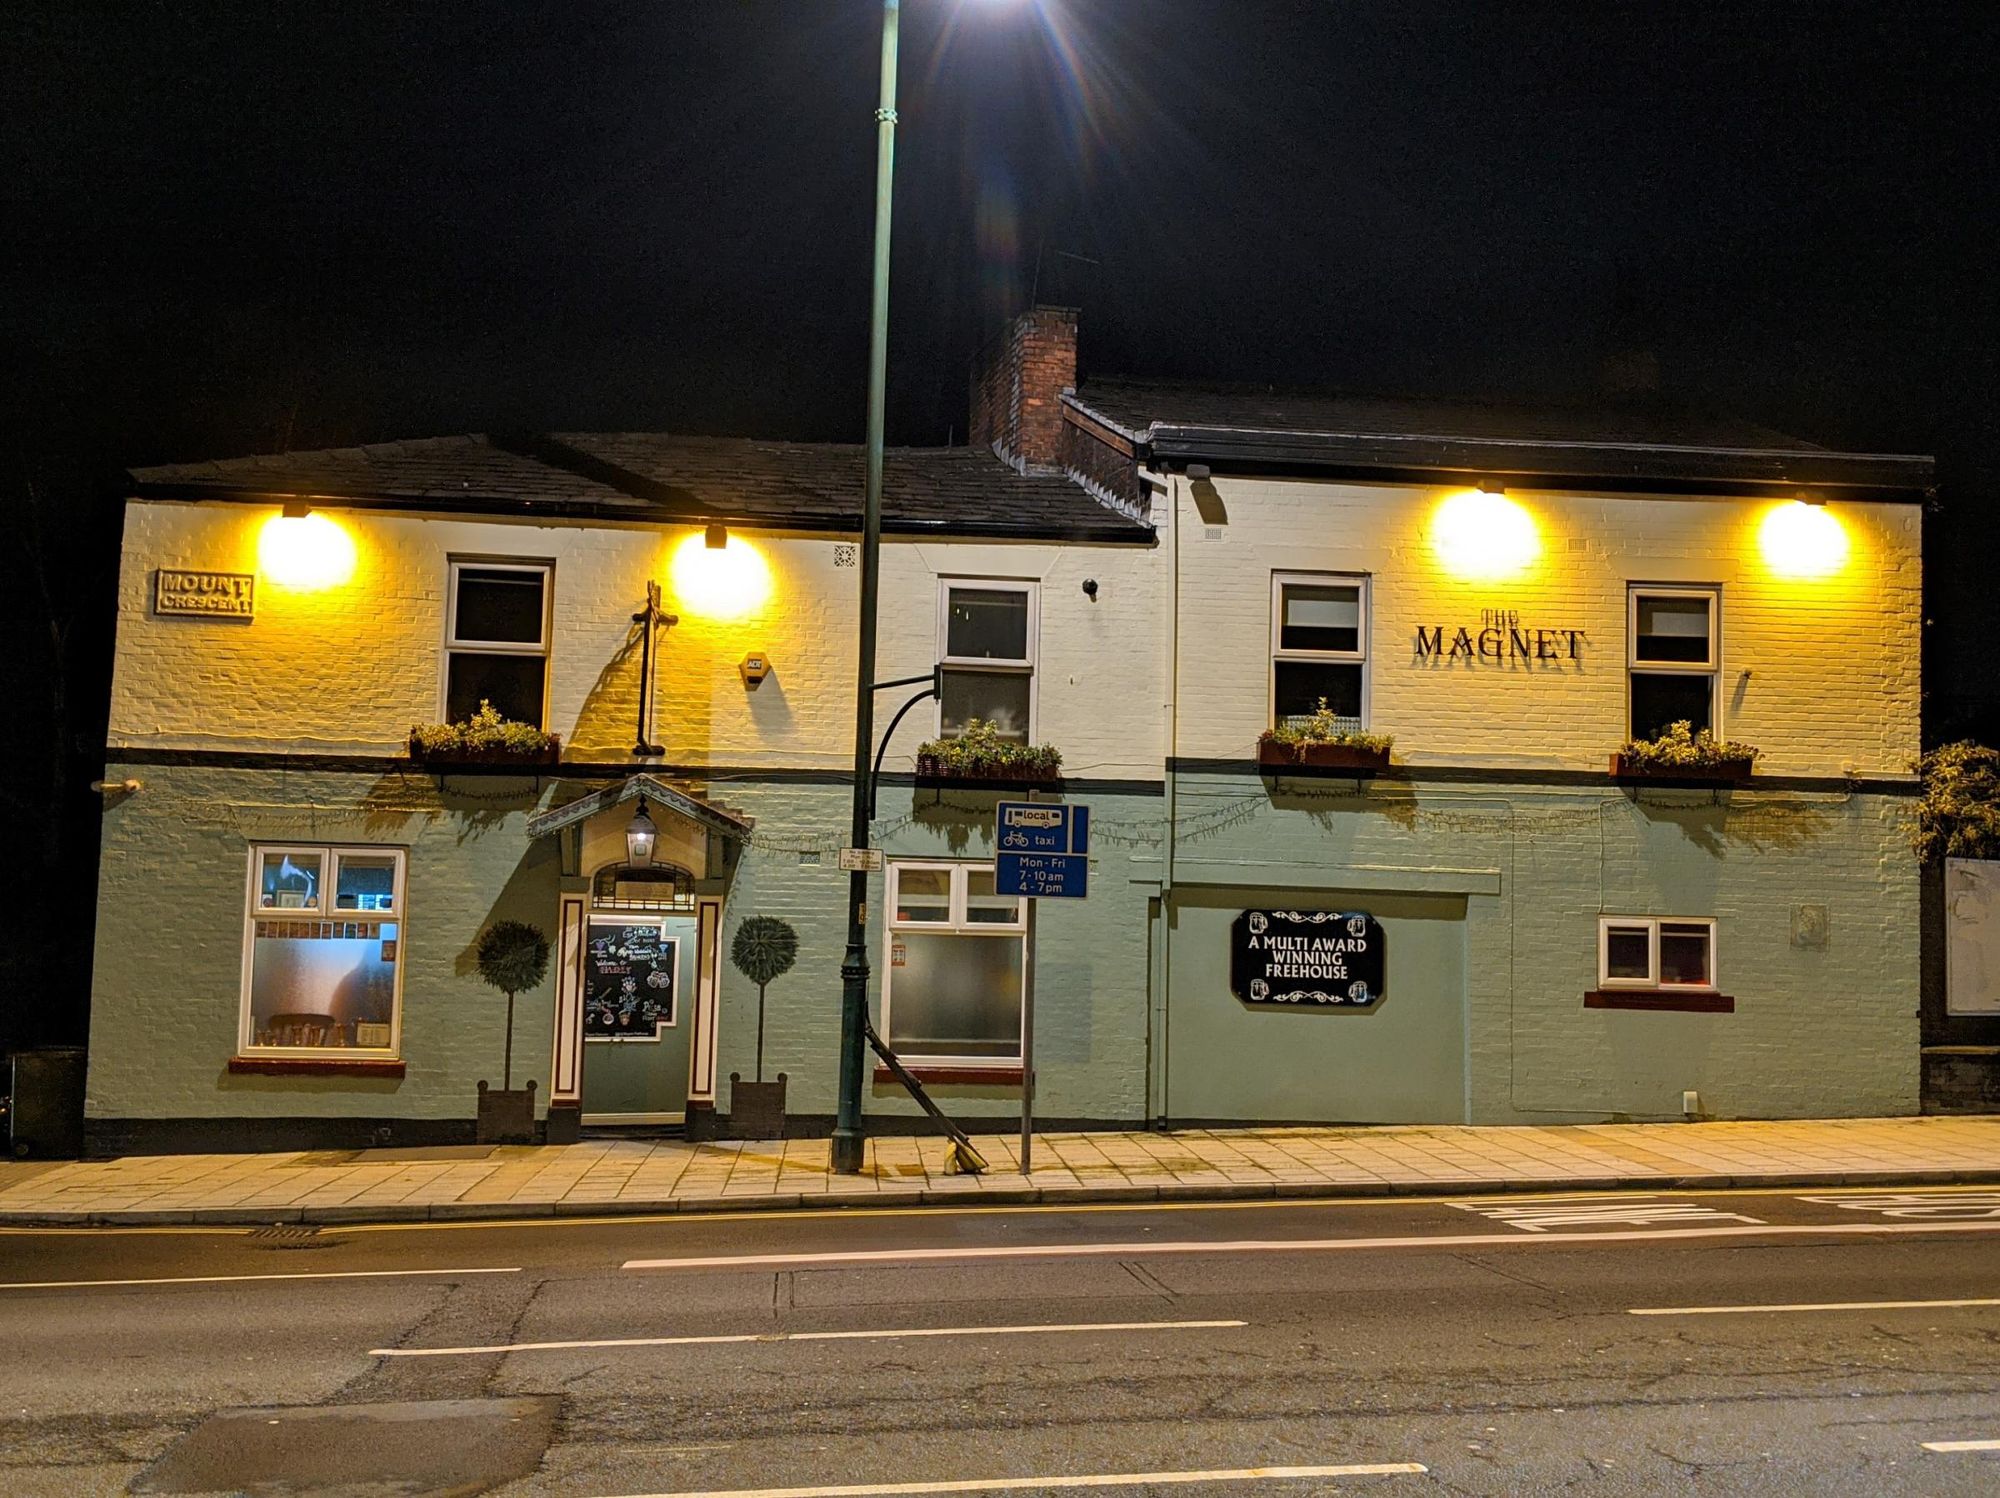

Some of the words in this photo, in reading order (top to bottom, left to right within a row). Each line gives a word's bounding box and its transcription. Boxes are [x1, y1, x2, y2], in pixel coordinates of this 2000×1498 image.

[163, 574, 251, 593] MOUNT
[163, 594, 251, 610] CRESCENT
[1481, 608, 1519, 624] THE
[1415, 625, 1585, 659] MAGNET
[747, 660, 762, 668] ADT
[1023, 810, 1050, 820] local
[1035, 836, 1055, 845] taxi
[1019, 857, 1043, 867] Mon
[1051, 858, 1066, 869] Fri
[1248, 935, 1260, 949] A
[1263, 936, 1308, 950] MULTI
[1312, 938, 1367, 952] AWARD
[1273, 951, 1342, 965] WINNING
[1265, 964, 1348, 979] FREEHOUSE
